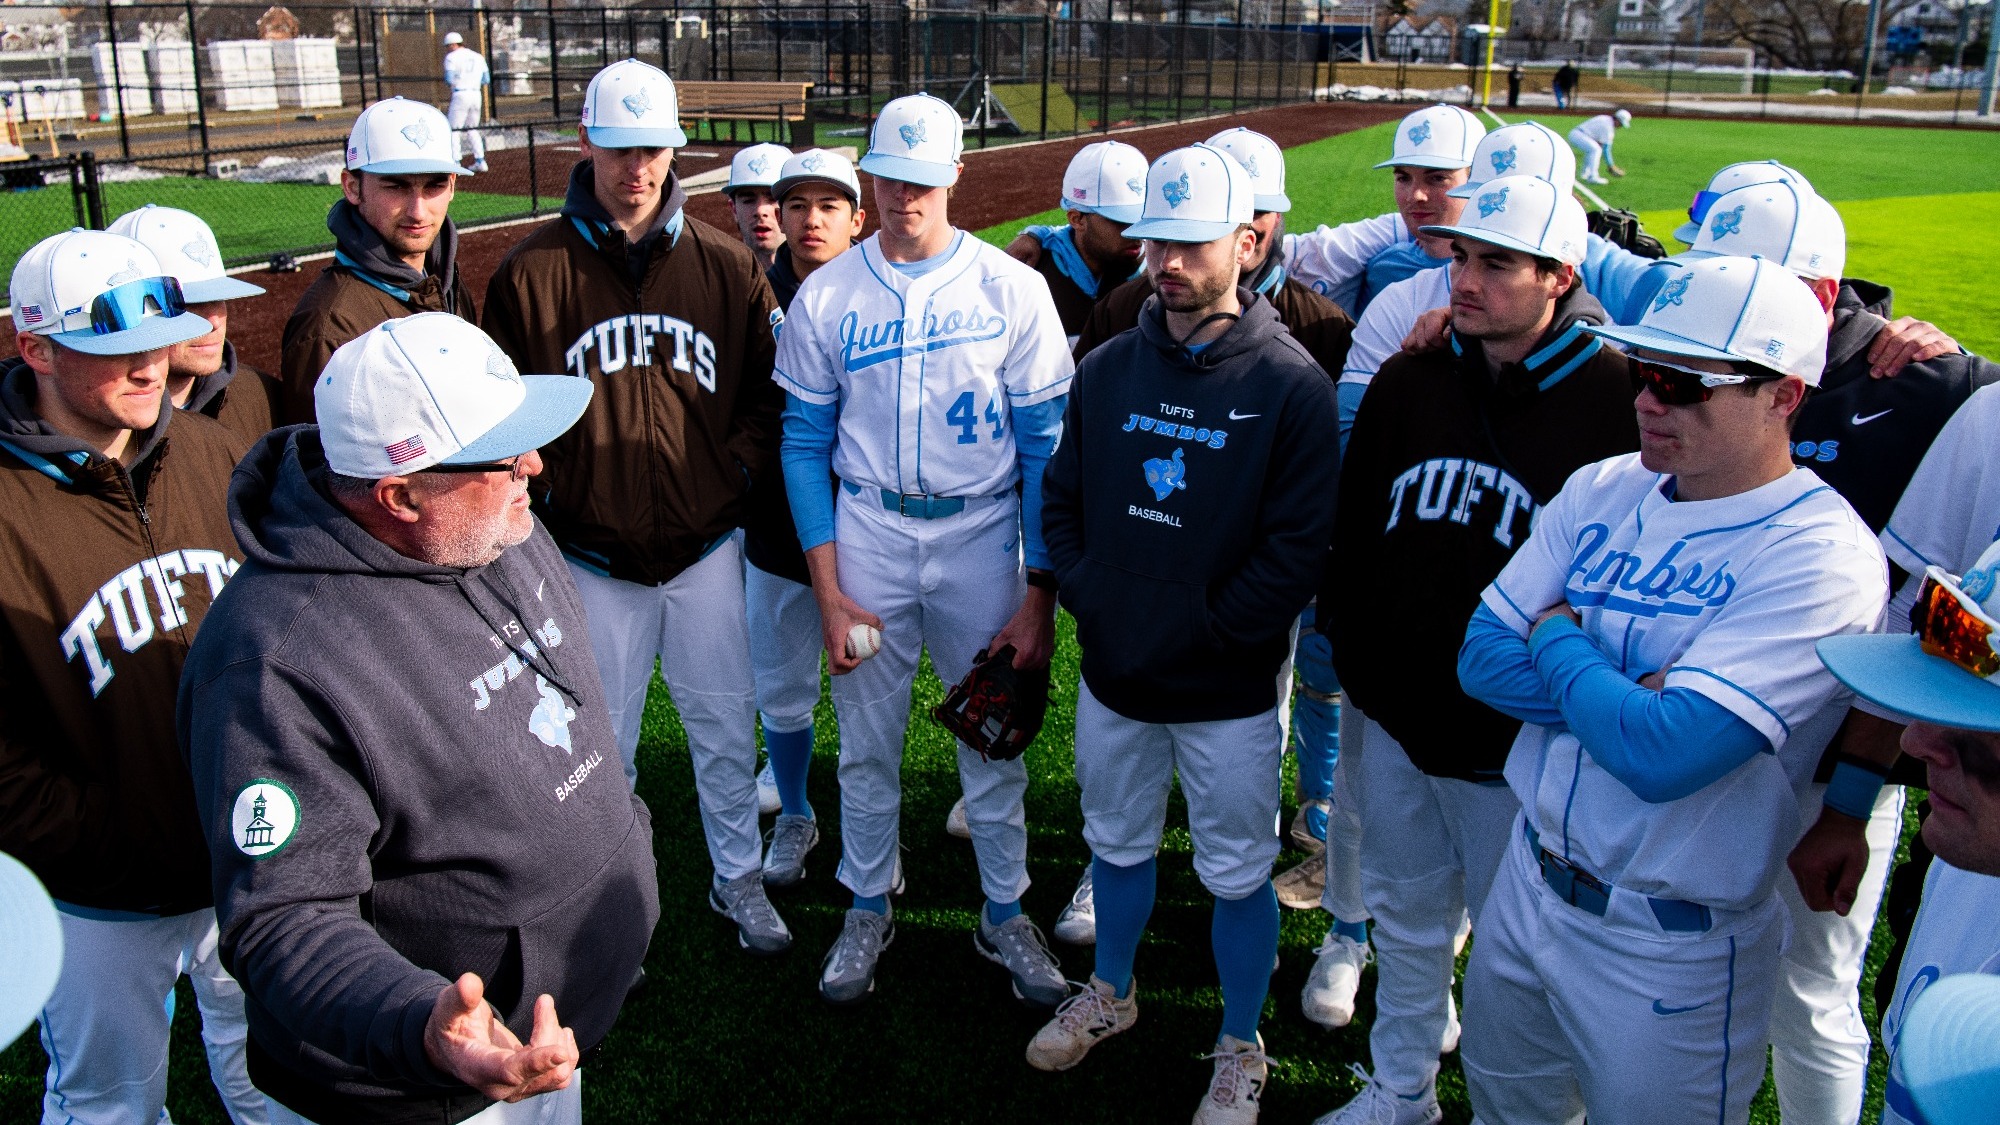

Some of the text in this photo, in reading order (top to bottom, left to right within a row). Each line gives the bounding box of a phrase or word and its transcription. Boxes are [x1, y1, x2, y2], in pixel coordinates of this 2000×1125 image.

[565, 313, 717, 394] TUFTS
[839, 295, 1007, 374] Jumbos
[945, 387, 1004, 445] 44
[1122, 413, 1229, 449] JUMBOS
[1160, 403, 1195, 419] TUFTS
[1128, 504, 1182, 528] BASEBALL
[58, 548, 241, 700] TUFT
[489, 620, 520, 650] TUTS
[554, 750, 603, 802] BASEBALL
